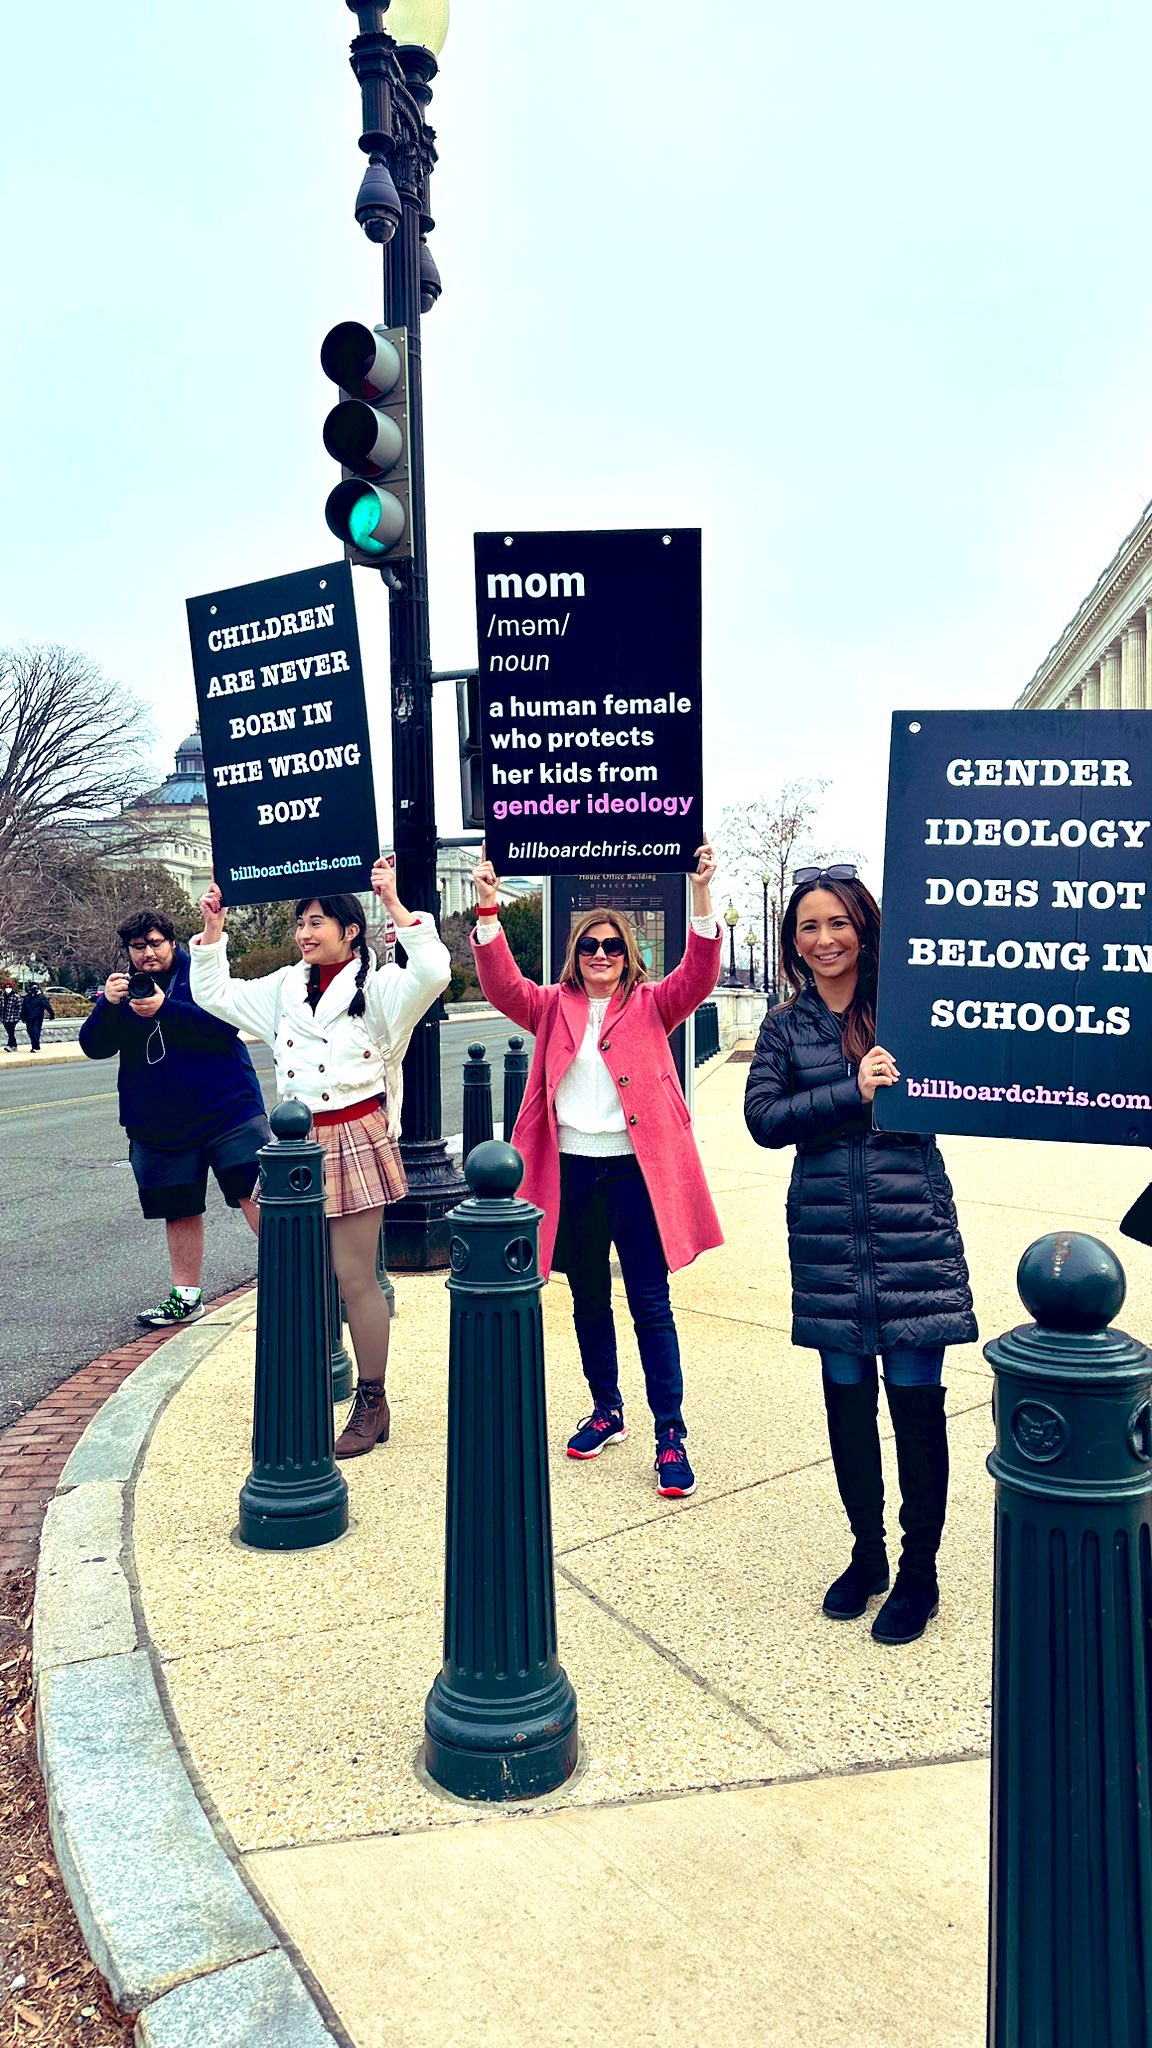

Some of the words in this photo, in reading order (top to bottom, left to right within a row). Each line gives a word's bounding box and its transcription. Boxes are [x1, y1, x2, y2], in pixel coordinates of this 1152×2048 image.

[487, 572, 585, 598] mom
[208, 604, 335, 652] CHILDREN
[206, 669, 256, 699] ARE
[260, 650, 350, 688] NEVER
[489, 655, 550, 672] noun
[489, 701, 503, 717] a
[510, 696, 597, 717] human
[603, 692, 692, 715] female
[229, 708, 297, 740] BORN
[302, 700, 333, 726] IN
[490, 728, 542, 749] who
[548, 727, 655, 753] protects
[213, 760, 264, 788] THE
[268, 743, 361, 778] WRONG
[492, 764, 534, 784] her
[539, 762, 593, 784] kids
[598, 762, 658, 783] from
[946, 758, 1133, 787] GENDER
[257, 796, 322, 826] BODY
[492, 794, 581, 820] gender
[587, 792, 694, 816] ideology
[924, 818, 1151, 849] IDEOLOGY
[508, 841, 681, 859] billboardchris.com
[230, 854, 362, 881] billboardchris.com
[924, 877, 1039, 907] DOES
[1052, 881, 1146, 910] NOT
[907, 937, 1091, 971] BELONG
[1101, 944, 1152, 974] IN
[930, 998, 1131, 1036] SCHOOLS
[906, 1077, 1152, 1111] billboardchris.com
